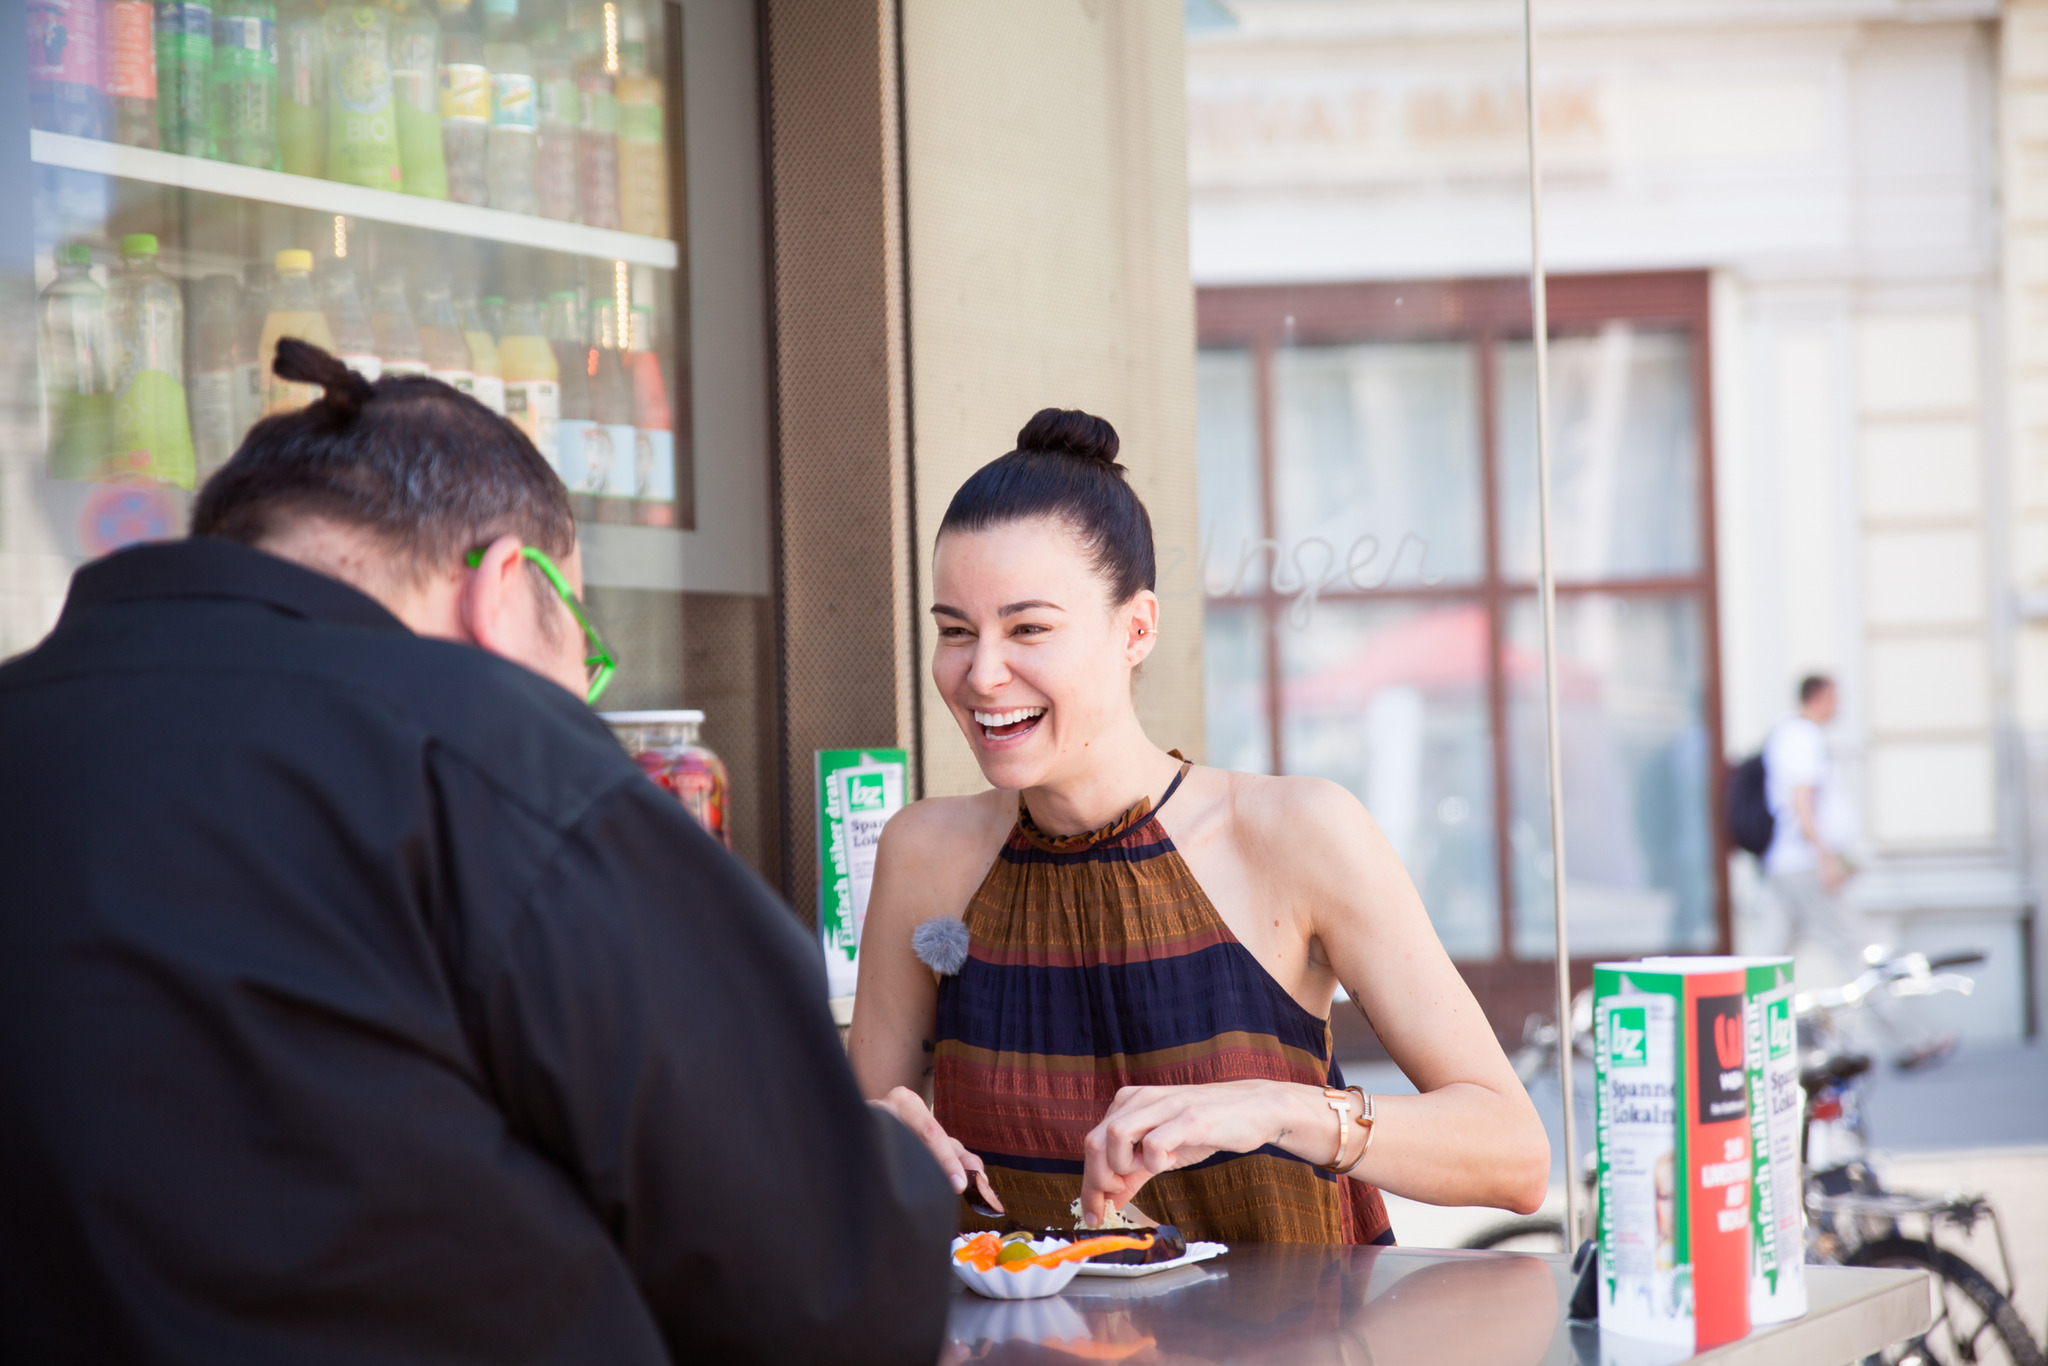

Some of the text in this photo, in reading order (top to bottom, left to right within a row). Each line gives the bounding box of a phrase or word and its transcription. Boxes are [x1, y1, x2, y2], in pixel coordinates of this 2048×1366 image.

[346, 118, 388, 142] BIO
[851, 777, 882, 804] bz
[828, 820, 848, 875] näher
[833, 877, 854, 947] Einfach
[1612, 1013, 1645, 1059] bz
[1751, 1074, 1769, 1158] näher
[1754, 1164, 1776, 1271] Einfach
